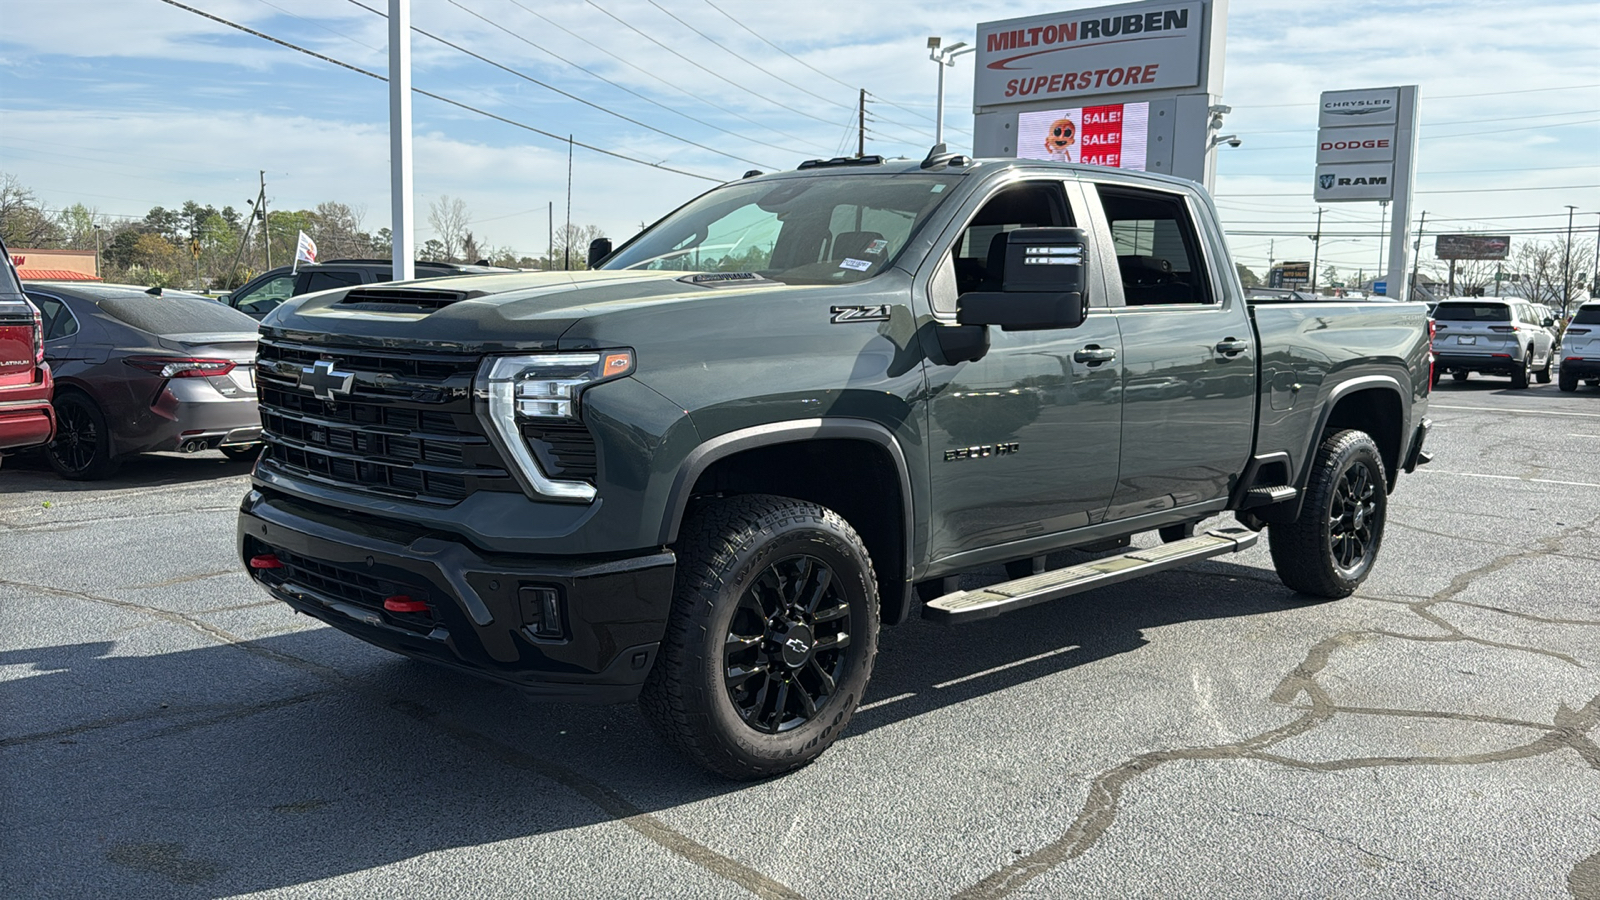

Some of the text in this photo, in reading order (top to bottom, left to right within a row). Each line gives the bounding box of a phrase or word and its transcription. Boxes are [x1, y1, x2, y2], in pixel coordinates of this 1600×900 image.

[986, 8, 1189, 53] MILTON RUBEN
[1004, 63, 1159, 97] SUPERSTORE
[1324, 99, 1391, 109] CHRYSLER
[1083, 111, 1121, 125] SALE!
[1082, 132, 1120, 146] SALE!
[1320, 139, 1390, 151] DODGE
[1081, 154, 1119, 166] SALE!
[1337, 176, 1388, 186] RAM
[830, 304, 892, 324] Z71
[0, 359, 30, 367] LATINUM
